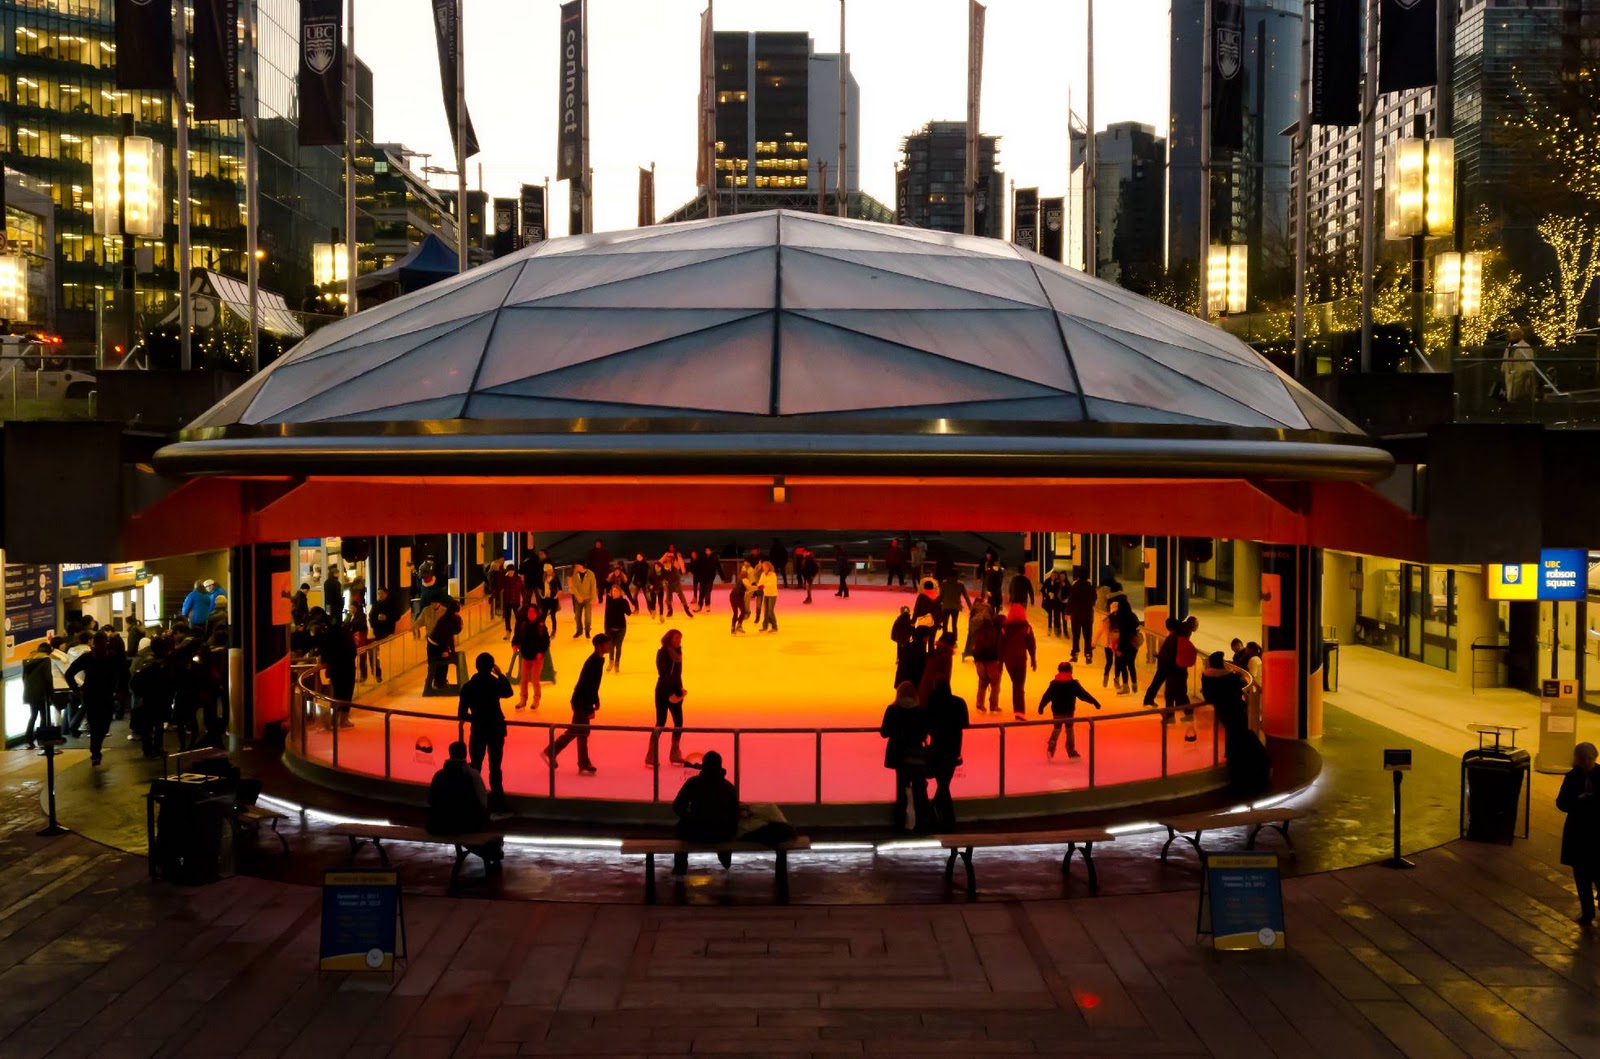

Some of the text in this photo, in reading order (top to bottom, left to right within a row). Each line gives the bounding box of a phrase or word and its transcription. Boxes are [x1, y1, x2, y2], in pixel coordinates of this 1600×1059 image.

[226, 13, 234, 25] OF
[1317, 18, 1325, 32] OF
[306, 26, 333, 39] UBC
[1219, 31, 1239, 45] UBC
[227, 29, 235, 88] UNIVERSITY
[1316, 34, 1325, 95] UNIVERSITY
[564, 28, 577, 134] connect
[229, 93, 237, 111] THE
[1545, 560, 1561, 568] UBC
[1545, 569, 1576, 578] robson
[1545, 580, 1576, 589] square
